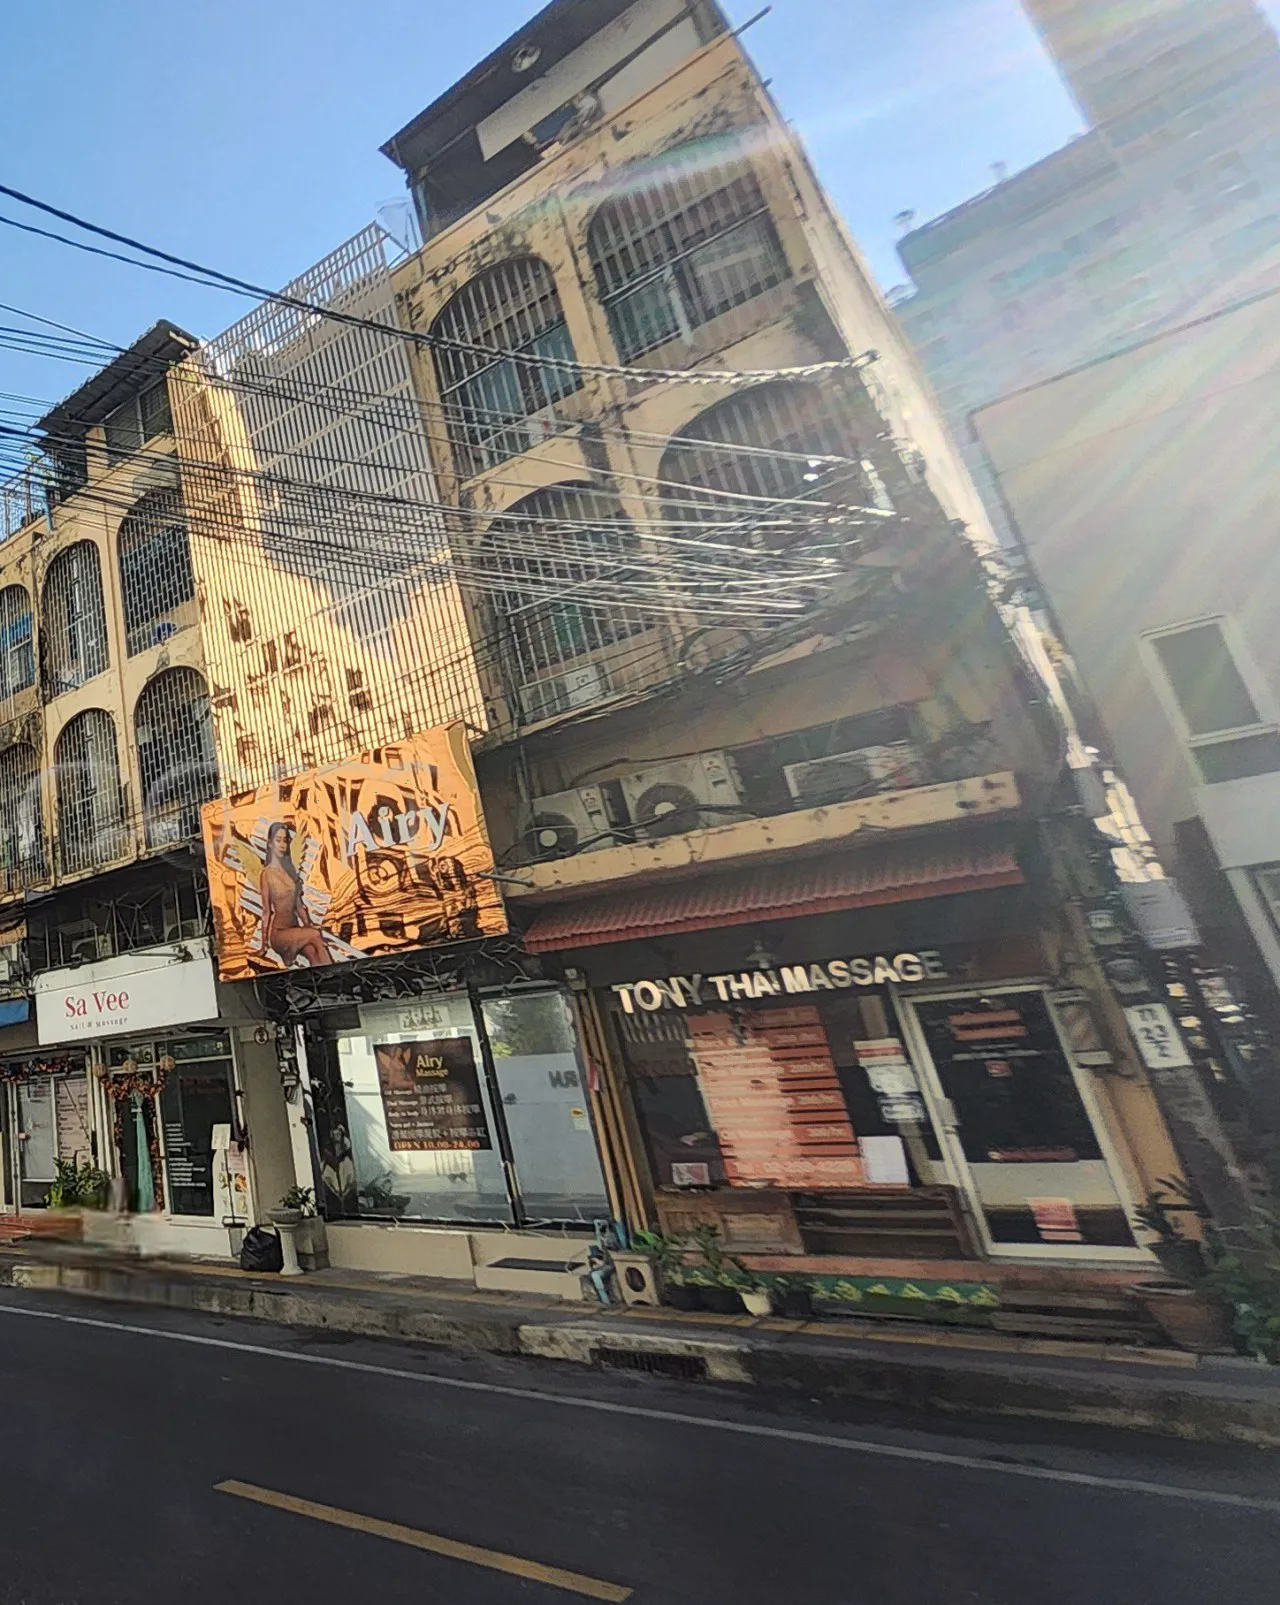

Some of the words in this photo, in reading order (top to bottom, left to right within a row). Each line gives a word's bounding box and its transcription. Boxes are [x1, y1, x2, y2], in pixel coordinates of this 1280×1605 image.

[347, 803, 450, 856] Airy
[611, 973, 702, 1014] TONY
[779, 950, 949, 993] MASSAGE
[64, 995, 88, 1018] Sa
[92, 990, 130, 1013] Vee
[415, 1068, 448, 1078] Massage
[416, 1054, 443, 1068] Airy
